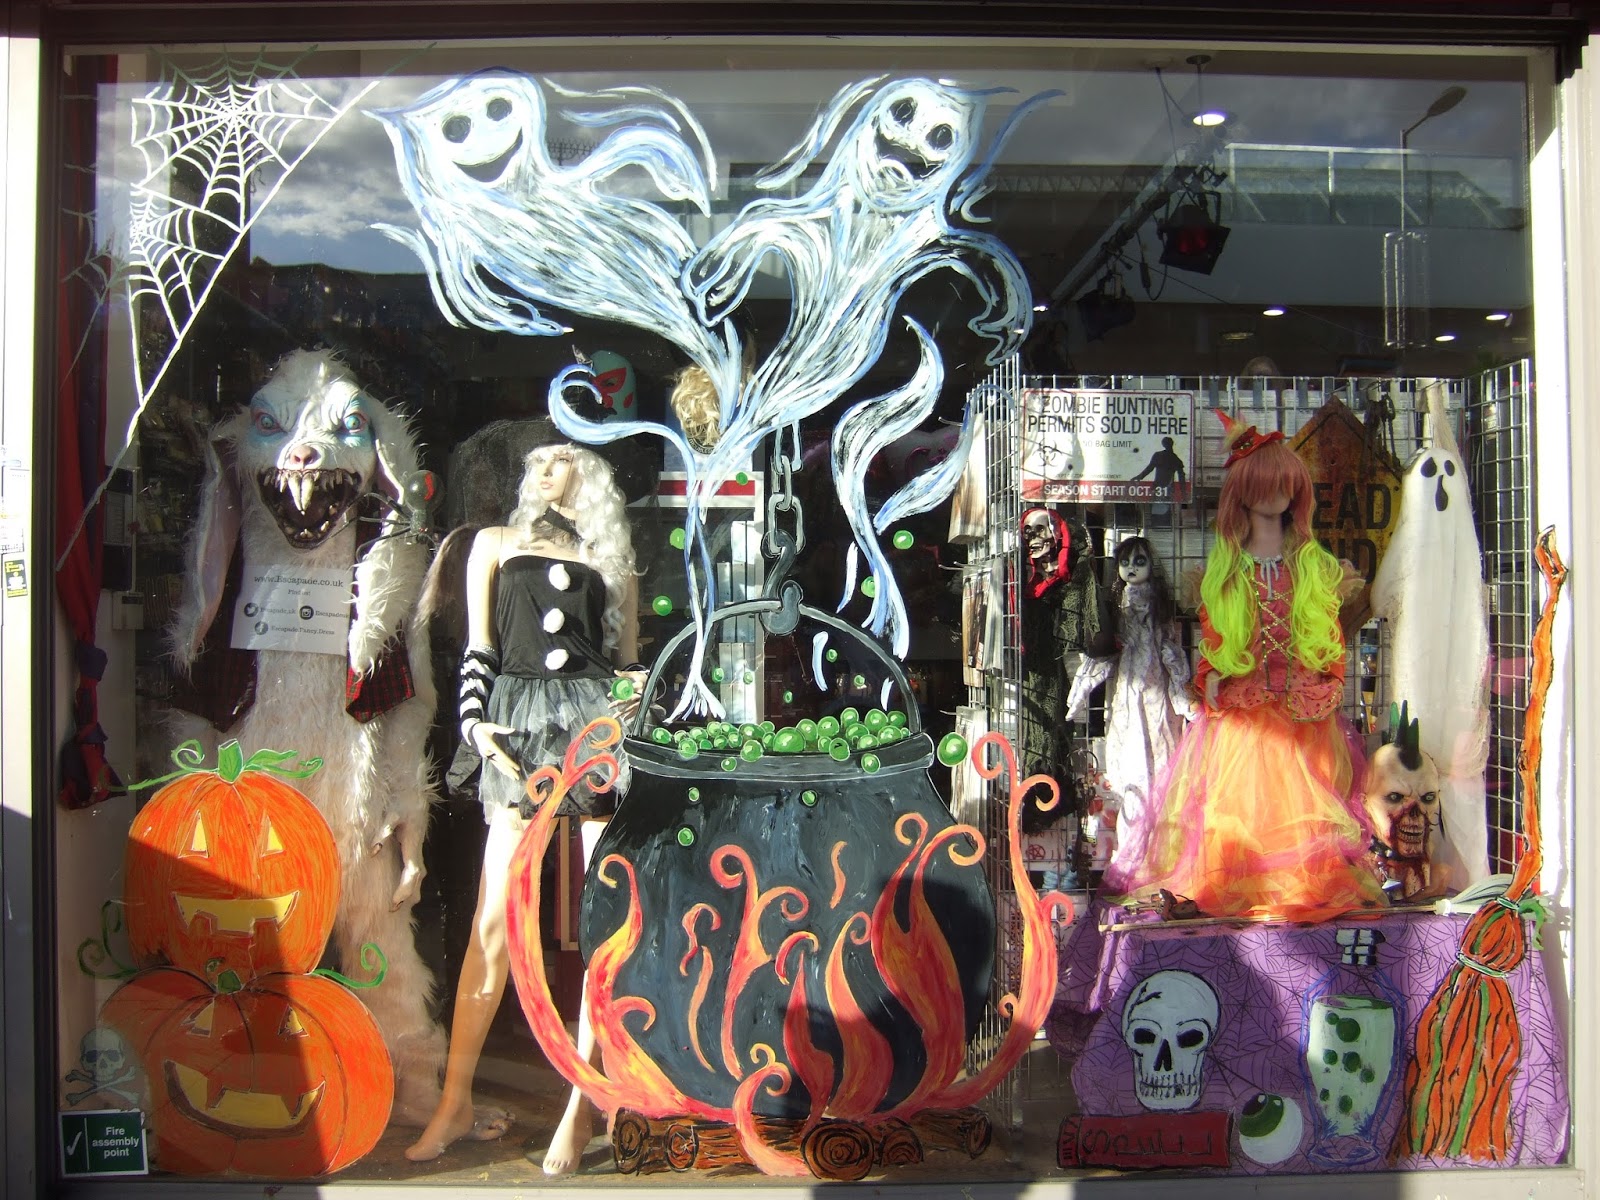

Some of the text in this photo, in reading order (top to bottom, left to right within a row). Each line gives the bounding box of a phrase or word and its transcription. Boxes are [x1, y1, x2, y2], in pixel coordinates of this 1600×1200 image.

[1041, 395, 1174, 415] ZOMBIE HUNTING
[1027, 415, 1188, 435] PERMITS SOLD HERE
[1095, 440, 1111, 448] BAG
[1112, 440, 1132, 448] LIMIT
[1044, 484, 1168, 497] SEASON START OCT. 31
[1312, 482, 1392, 529] EAD
[254, 575, 344, 588] www.Escapade.co.uk
[105, 1126, 125, 1136] Fire
[92, 1136, 140, 1148] assembly
[103, 1147, 130, 1160] point
